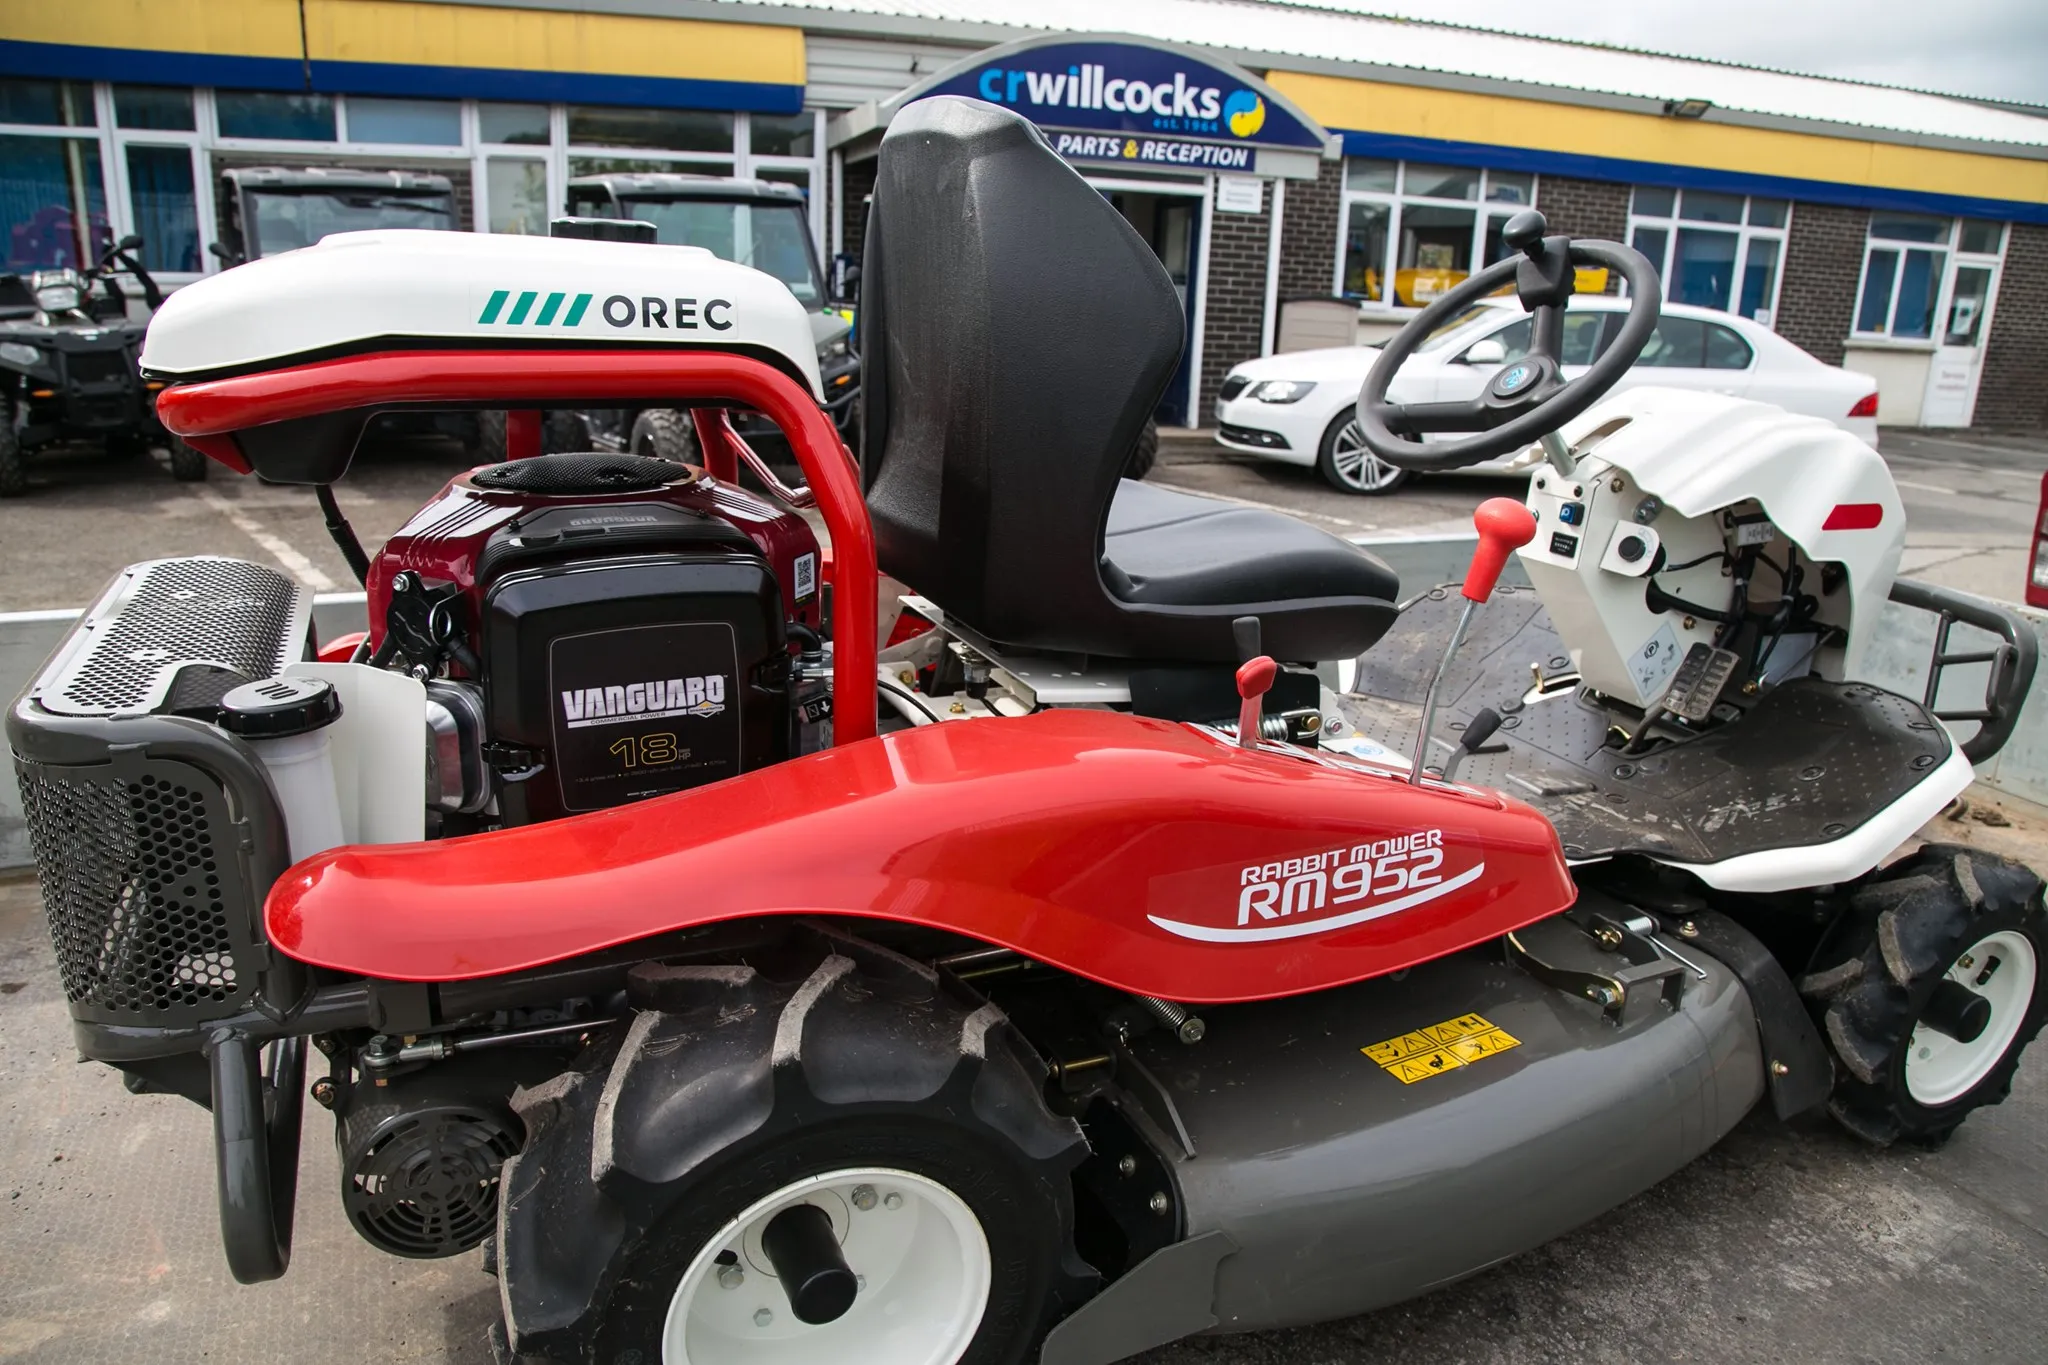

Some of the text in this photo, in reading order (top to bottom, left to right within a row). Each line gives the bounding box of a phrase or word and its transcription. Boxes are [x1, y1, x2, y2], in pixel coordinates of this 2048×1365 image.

[978, 63, 1221, 120] crwillcocks
[1057, 134, 1121, 158] PARTS
[1122, 139, 1139, 159] &
[1141, 140, 1248, 167] RECEPTION
[602, 295, 733, 331] OREC
[561, 674, 725, 721] VANGUARD
[590, 715, 639, 725] COMMERCIAL
[609, 732, 692, 768] 18 HP
[1240, 829, 1443, 886] RABBIT MOWER
